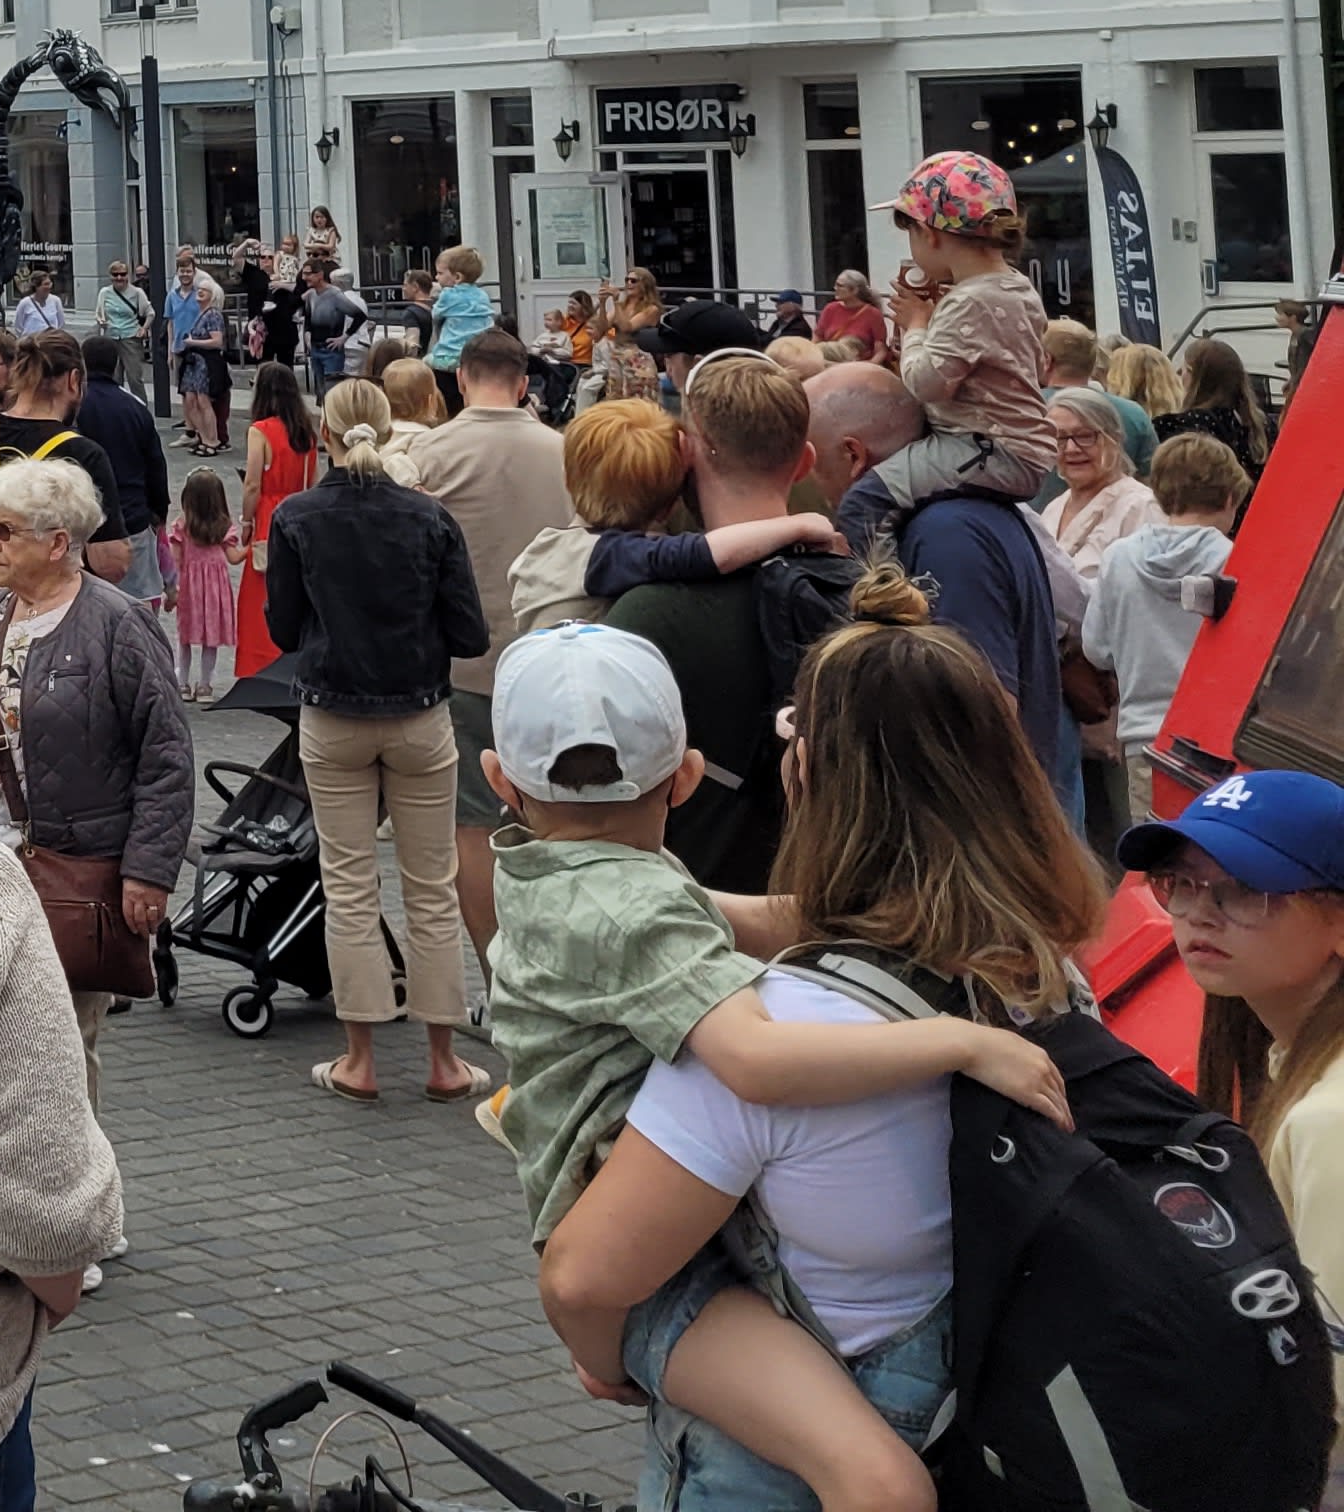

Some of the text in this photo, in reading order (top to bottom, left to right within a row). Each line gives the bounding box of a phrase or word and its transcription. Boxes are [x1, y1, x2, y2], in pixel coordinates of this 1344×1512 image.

[604, 98, 726, 132] FRISØR
[45, 241, 73, 252] Gourme
[1202, 775, 1253, 811] LA
